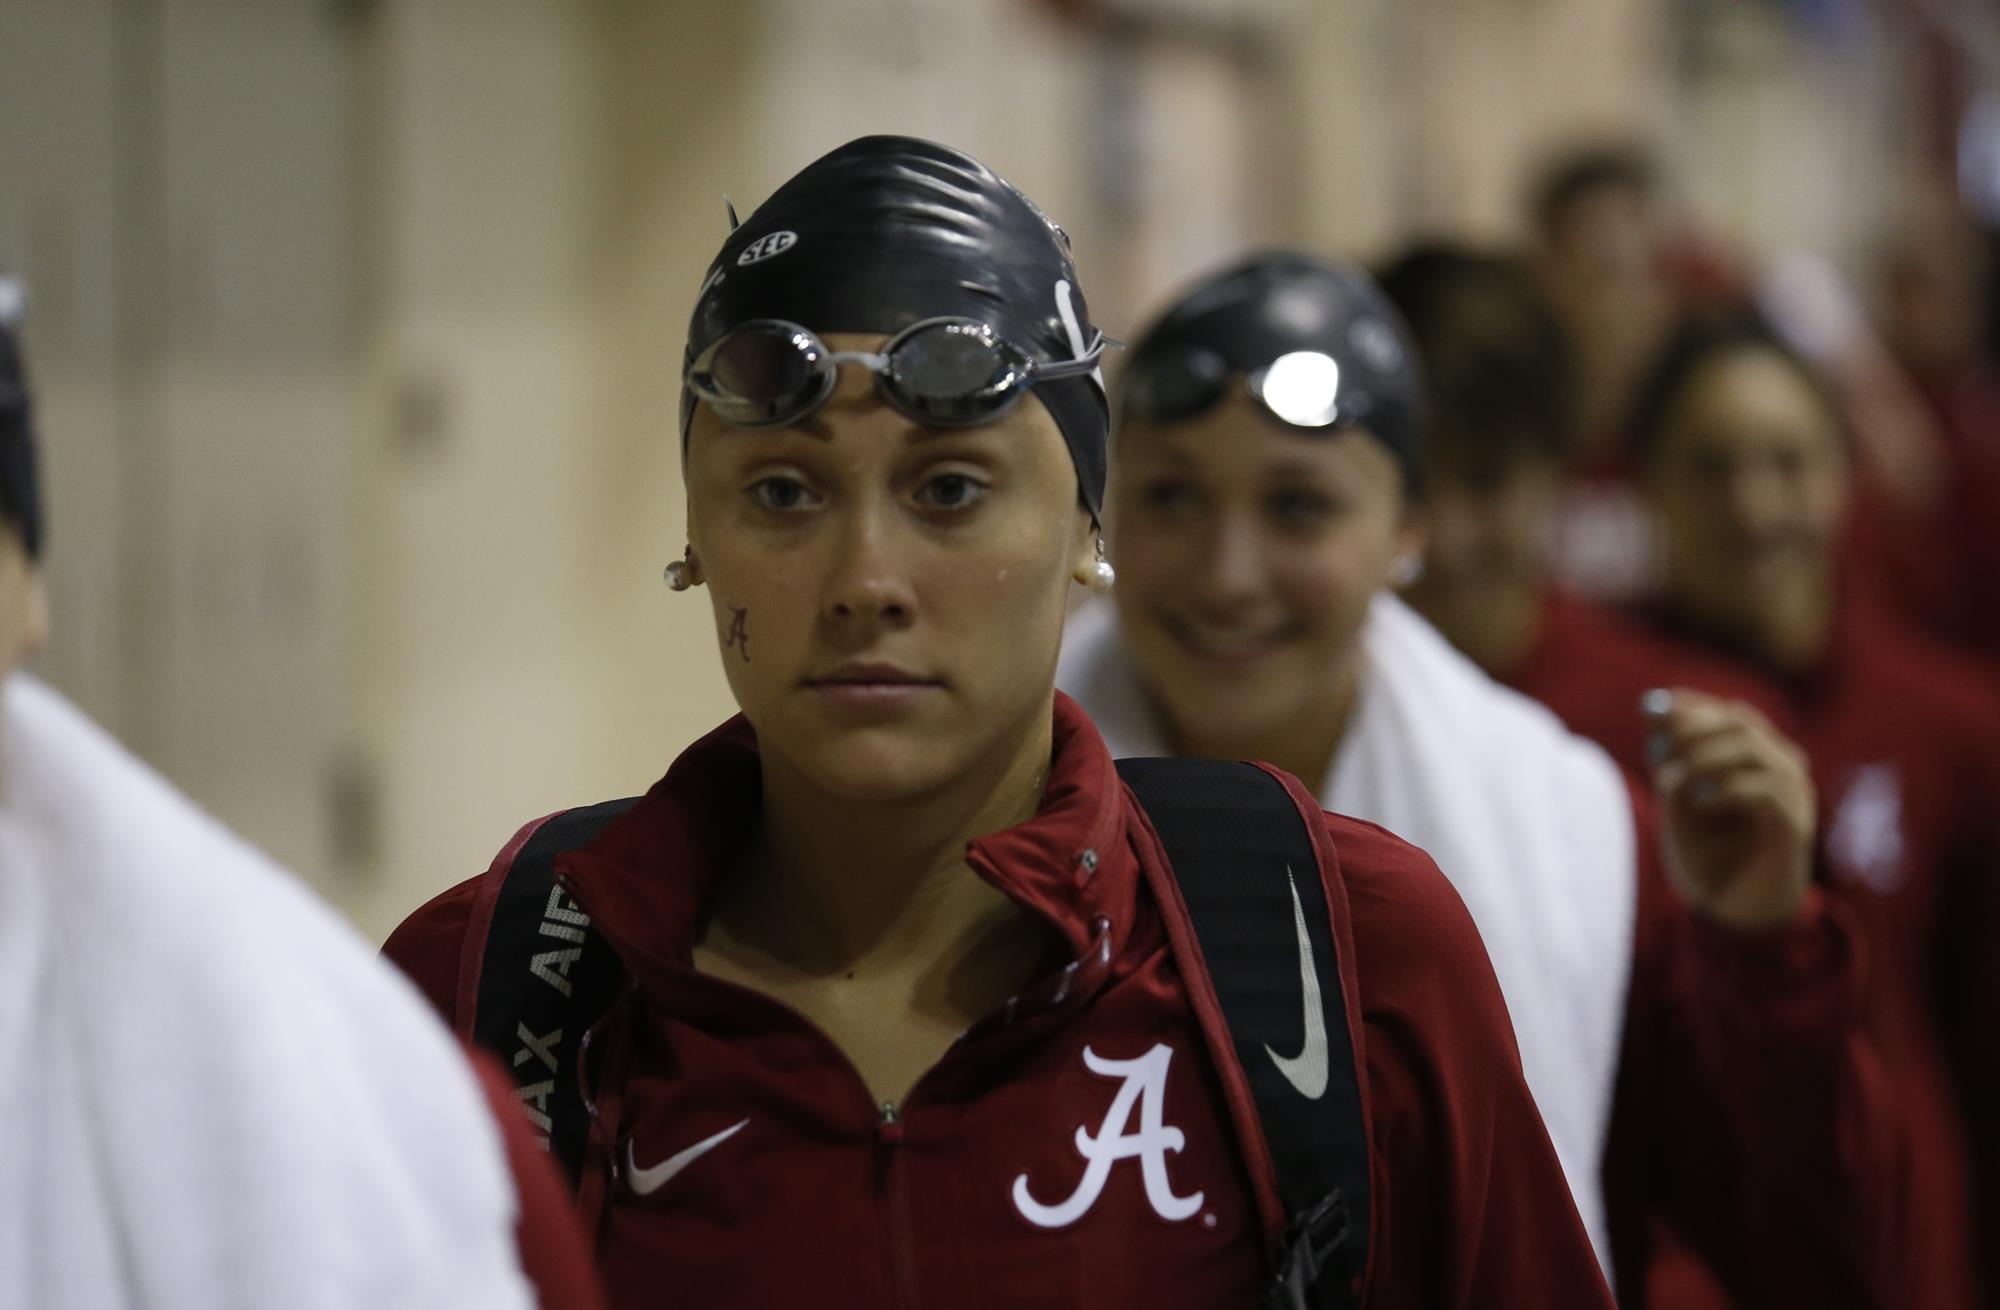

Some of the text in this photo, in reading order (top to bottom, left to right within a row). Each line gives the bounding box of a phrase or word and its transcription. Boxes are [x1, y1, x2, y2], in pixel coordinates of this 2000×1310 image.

[740, 233, 793, 262] SEC
[726, 600, 751, 662] A
[511, 1020, 562, 1152] AX
[1012, 1043, 1204, 1228] A
